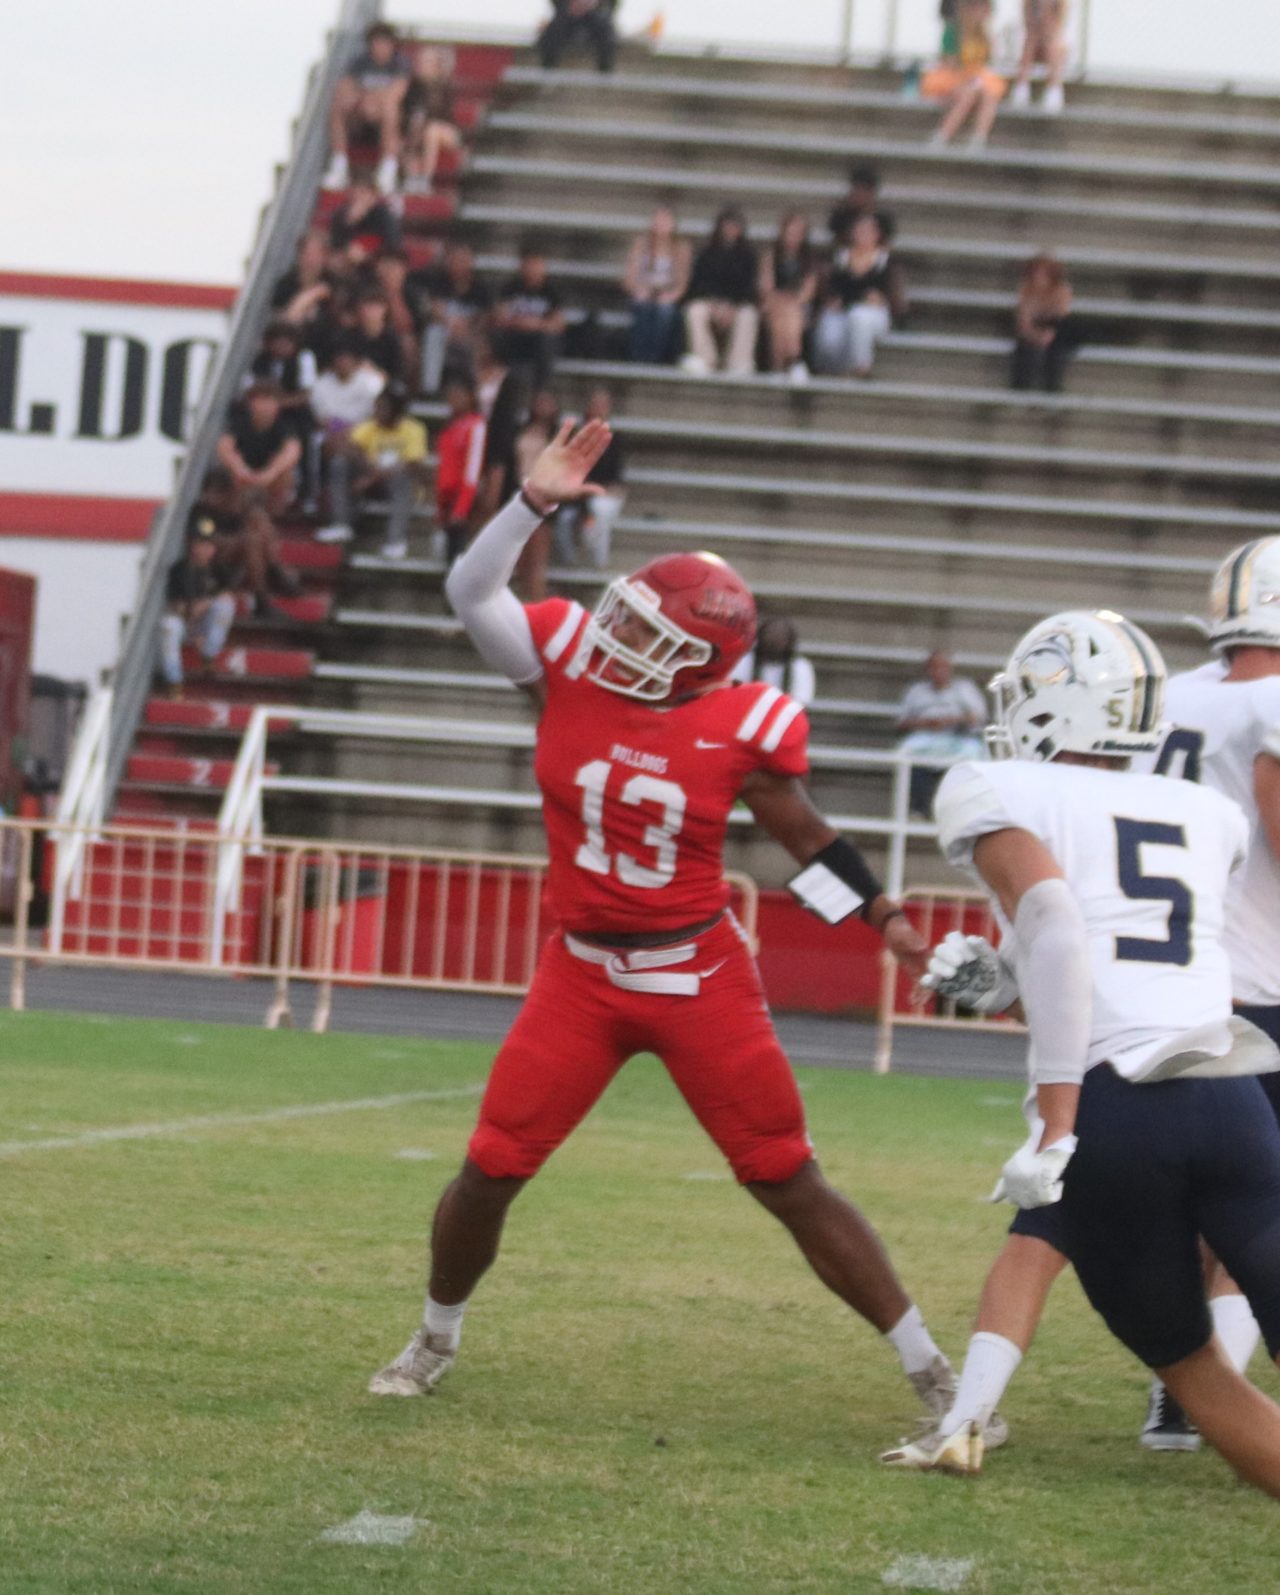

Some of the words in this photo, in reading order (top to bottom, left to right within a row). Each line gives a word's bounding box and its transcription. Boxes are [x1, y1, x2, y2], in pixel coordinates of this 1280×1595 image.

[1105, 698, 1124, 729] 5
[610, 744, 669, 774] BULLDOGS
[574, 759, 687, 888] 13
[1113, 816, 1194, 967] 5
